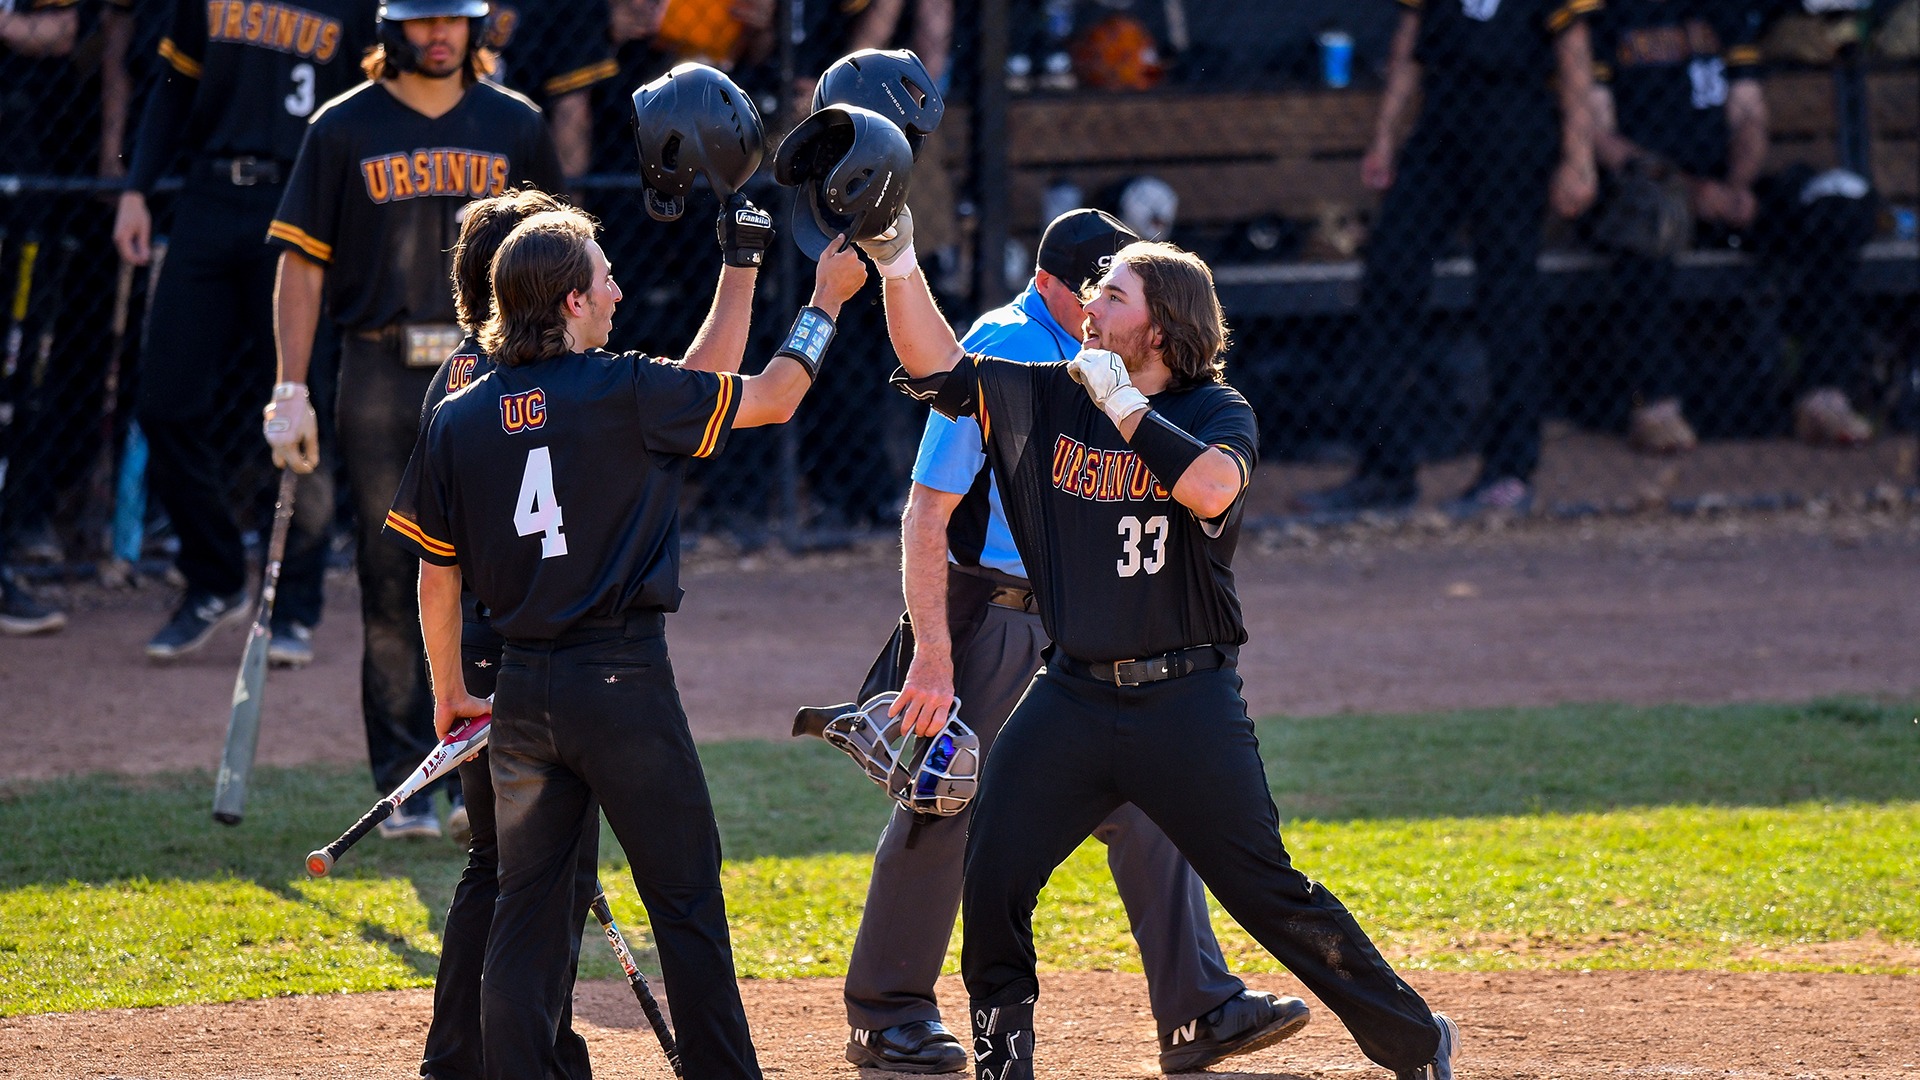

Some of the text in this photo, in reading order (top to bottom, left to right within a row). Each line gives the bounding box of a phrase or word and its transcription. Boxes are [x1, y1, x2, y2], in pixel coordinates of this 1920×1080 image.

[207, 0, 342, 64] URSINUS
[285, 63, 315, 117] 3
[361, 147, 510, 204] URSINUS
[445, 353, 478, 394] UC
[500, 387, 547, 435] UC
[513, 446, 568, 559] 4
[1117, 515, 1169, 577] 33
